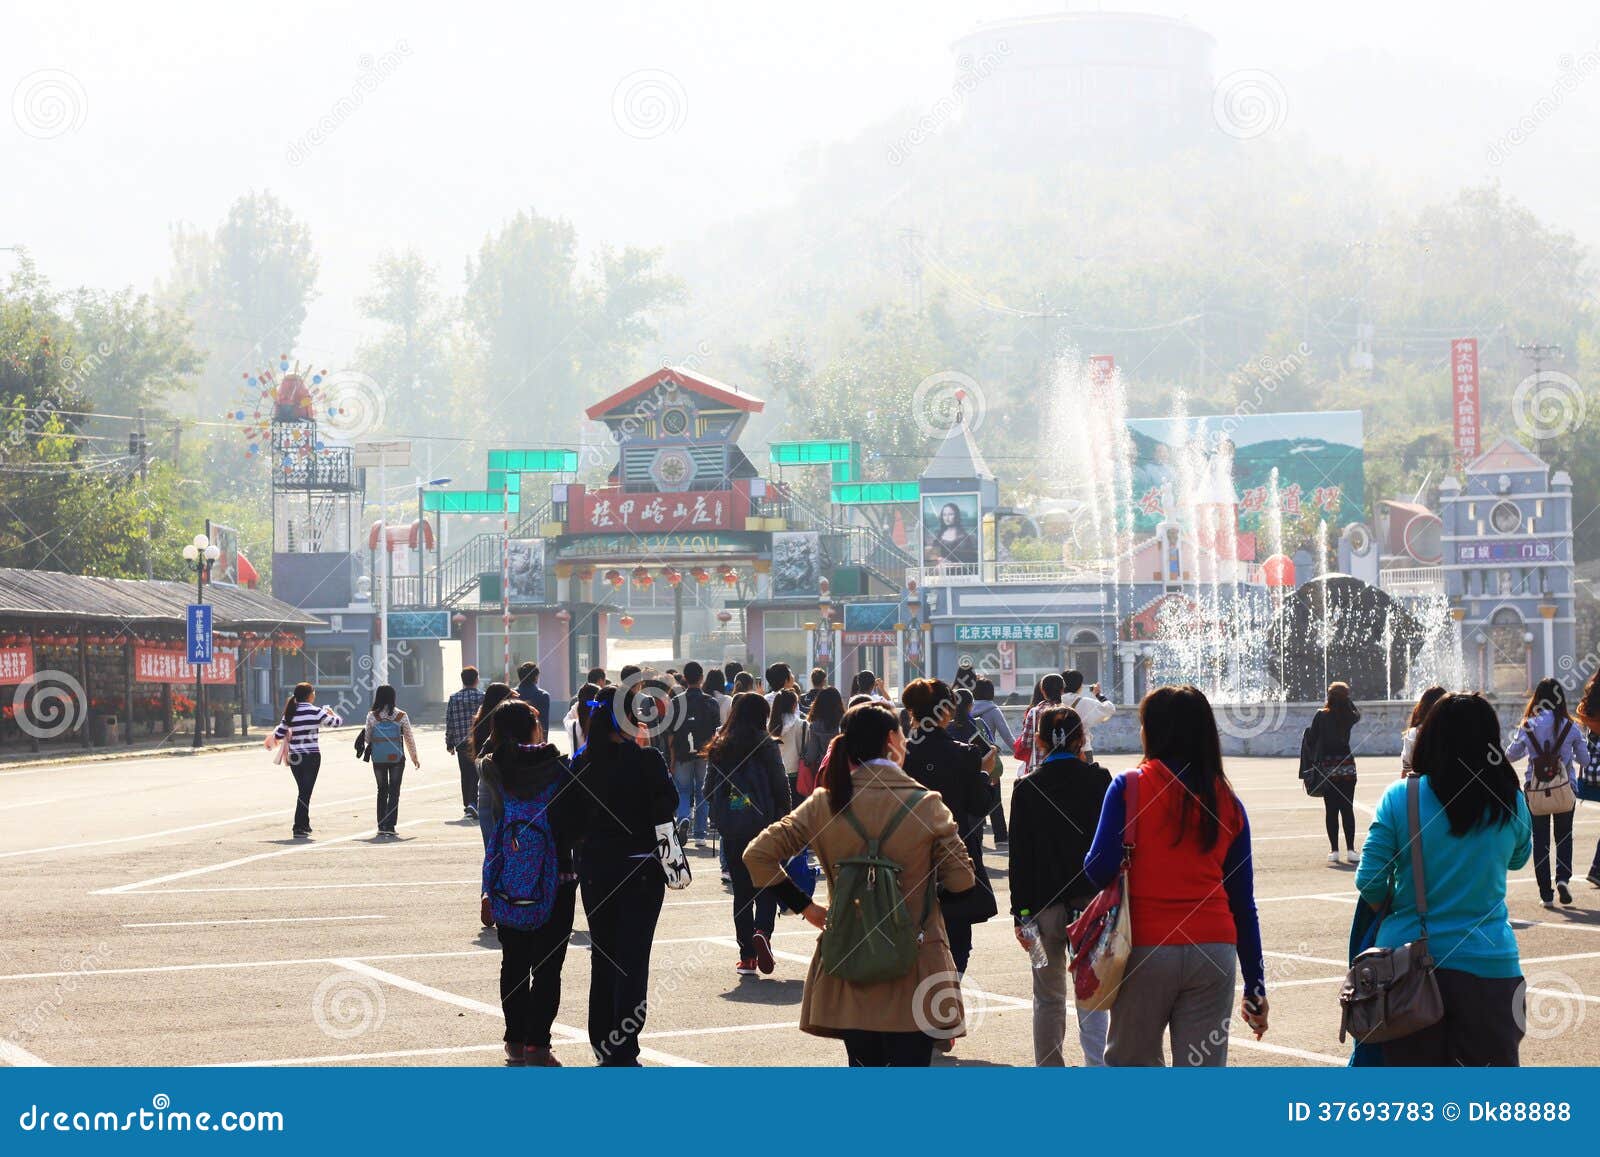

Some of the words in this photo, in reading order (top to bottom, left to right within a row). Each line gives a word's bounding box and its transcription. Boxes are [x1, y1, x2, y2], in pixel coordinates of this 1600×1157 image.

[1456, 342, 1475, 466] 伟大的中华人民共和国万
[1137, 484, 1341, 515] 发硬道理
[960, 625, 1055, 640] 北京天甲果品专卖店
